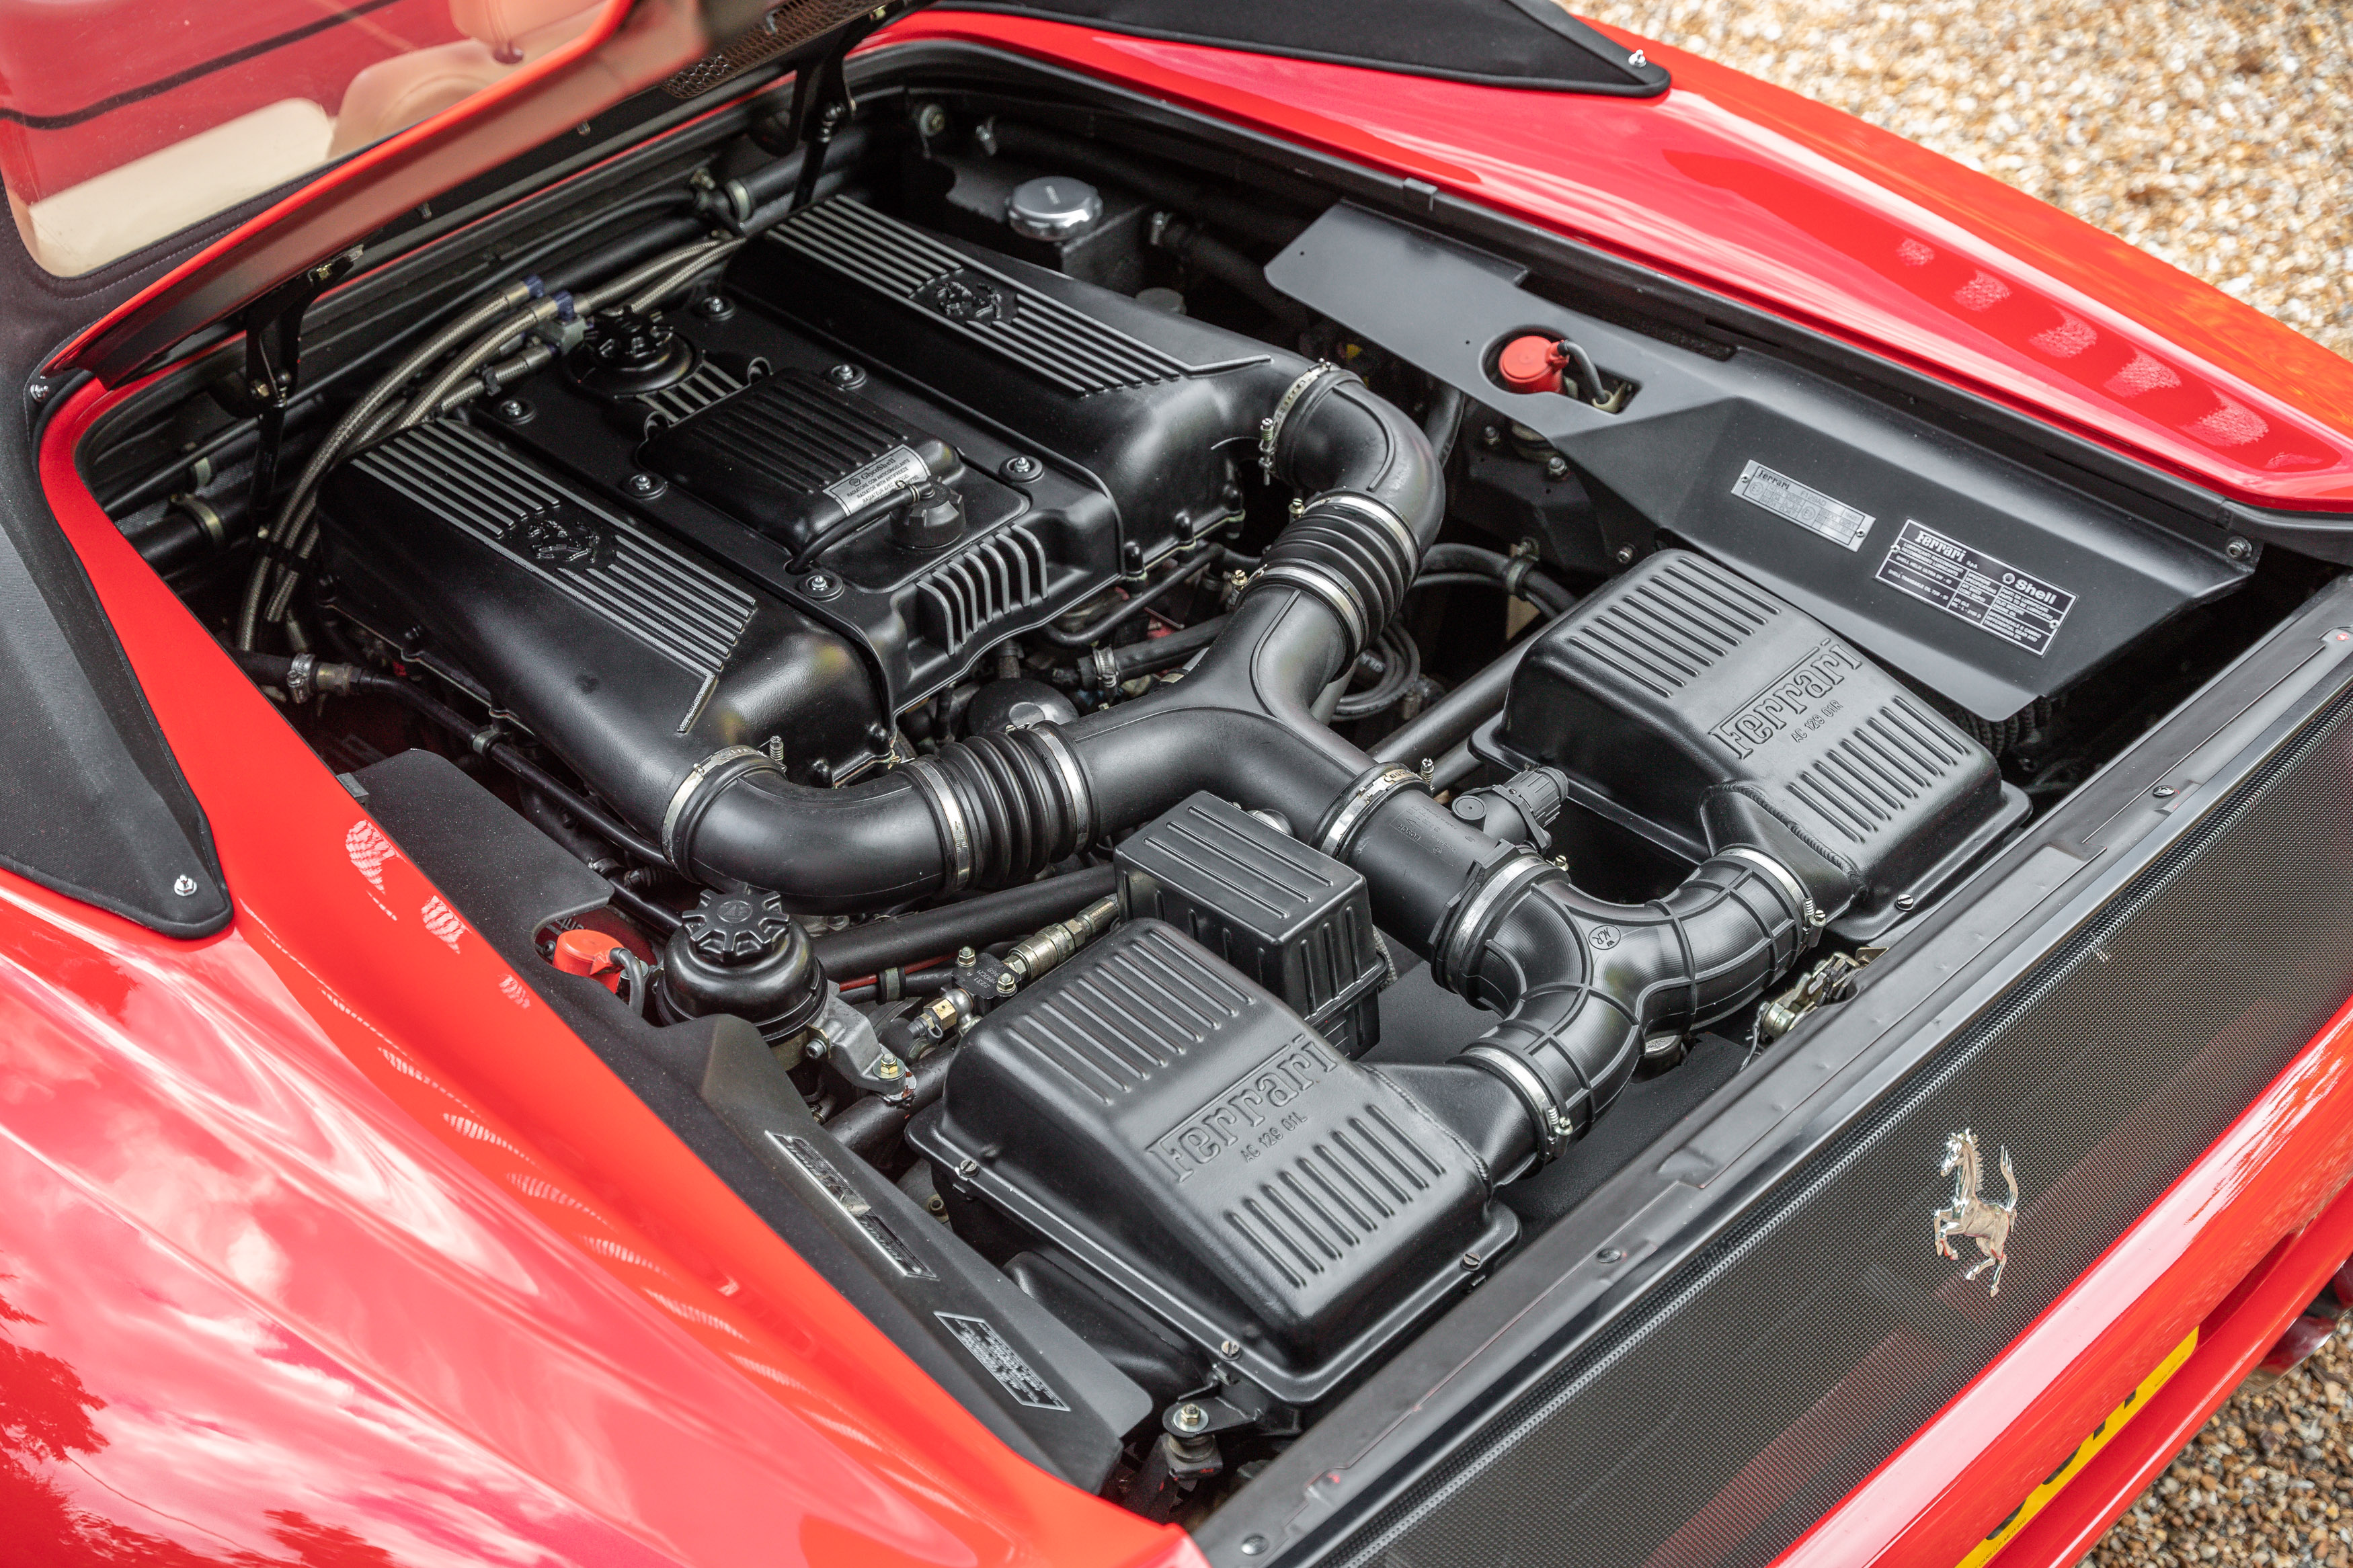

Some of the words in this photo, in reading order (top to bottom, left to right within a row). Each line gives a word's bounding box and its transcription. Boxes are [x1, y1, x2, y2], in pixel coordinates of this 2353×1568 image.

[846, 482, 869, 497] RADIATORE
[868, 476, 878, 485] CON
[877, 458, 911, 481] ANTICONGELANTE
[856, 485, 876, 499] RADIATOR
[885, 466, 908, 481] ANTIFREEZE
[861, 458, 897, 480] GlycoShell
[1758, 470, 1790, 490] Ferrari
[862, 489, 884, 503] RADIATEUR
[1914, 530, 1966, 563] Ferrari
[2013, 577, 2057, 605] Shell
[1708, 638, 1862, 759] Ferrari
[1791, 728, 1808, 743] AC
[1804, 714, 1825, 731] 129
[1821, 700, 1844, 718] 01R
[1397, 823, 1421, 841] BOSCH
[973, 977, 990, 988] 2231
[987, 968, 1000, 977] 968
[1145, 1034, 1338, 1183] Ferrari
[1240, 1145, 1261, 1163] AC
[1259, 1128, 1283, 1148] 129
[1281, 1112, 1308, 1131] 01L
